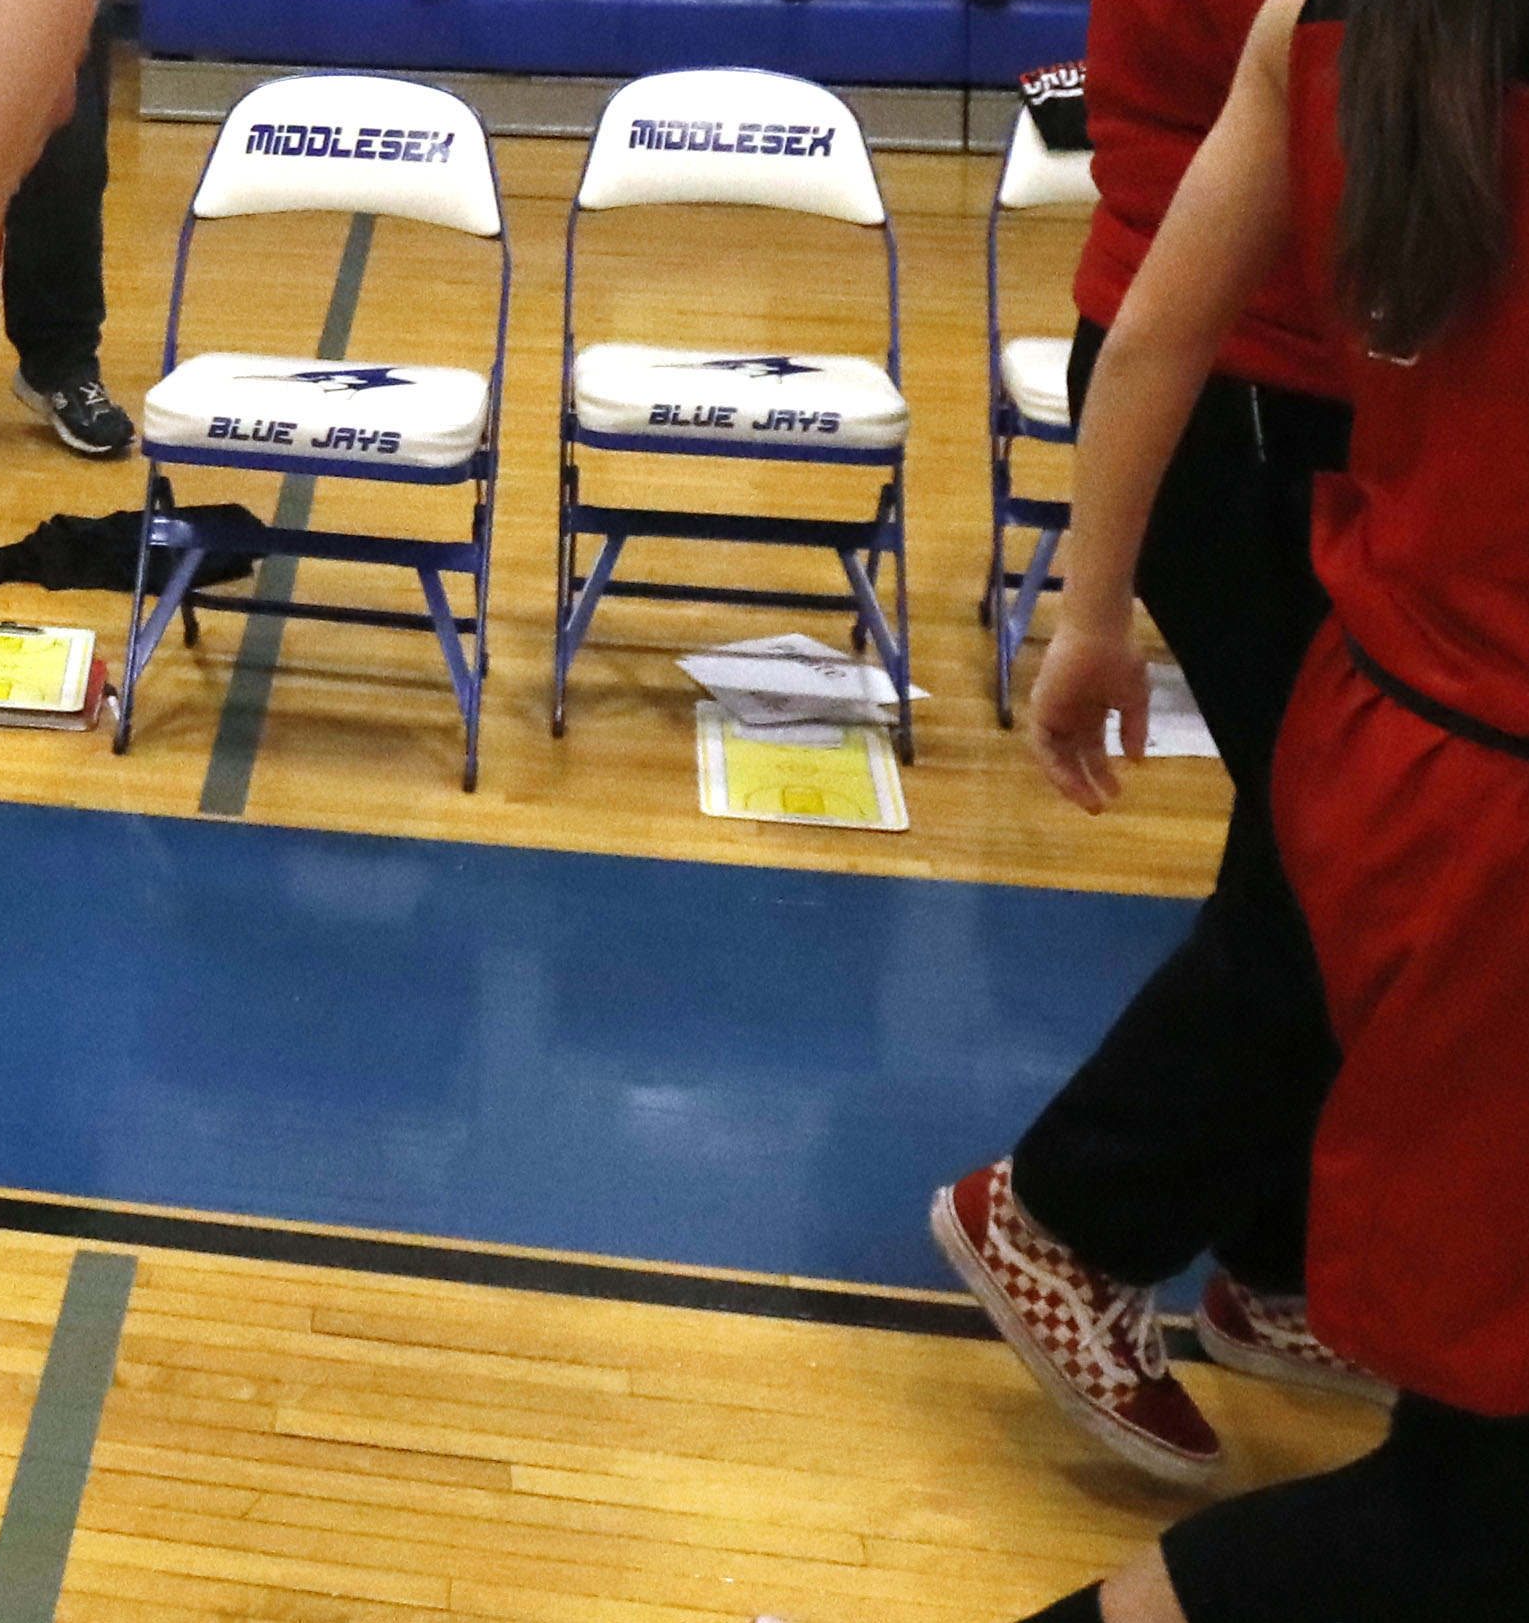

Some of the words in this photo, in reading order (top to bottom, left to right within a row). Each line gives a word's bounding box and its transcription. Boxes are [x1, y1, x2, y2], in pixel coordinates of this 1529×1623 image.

[245, 123, 456, 164] MIDDLESEX
[628, 119, 836, 157] MIDDLESEX
[208, 416, 298, 446] BLUE
[311, 426, 402, 454] JAYS
[648, 403, 738, 429] BLUE
[751, 408, 842, 434] JAYS
